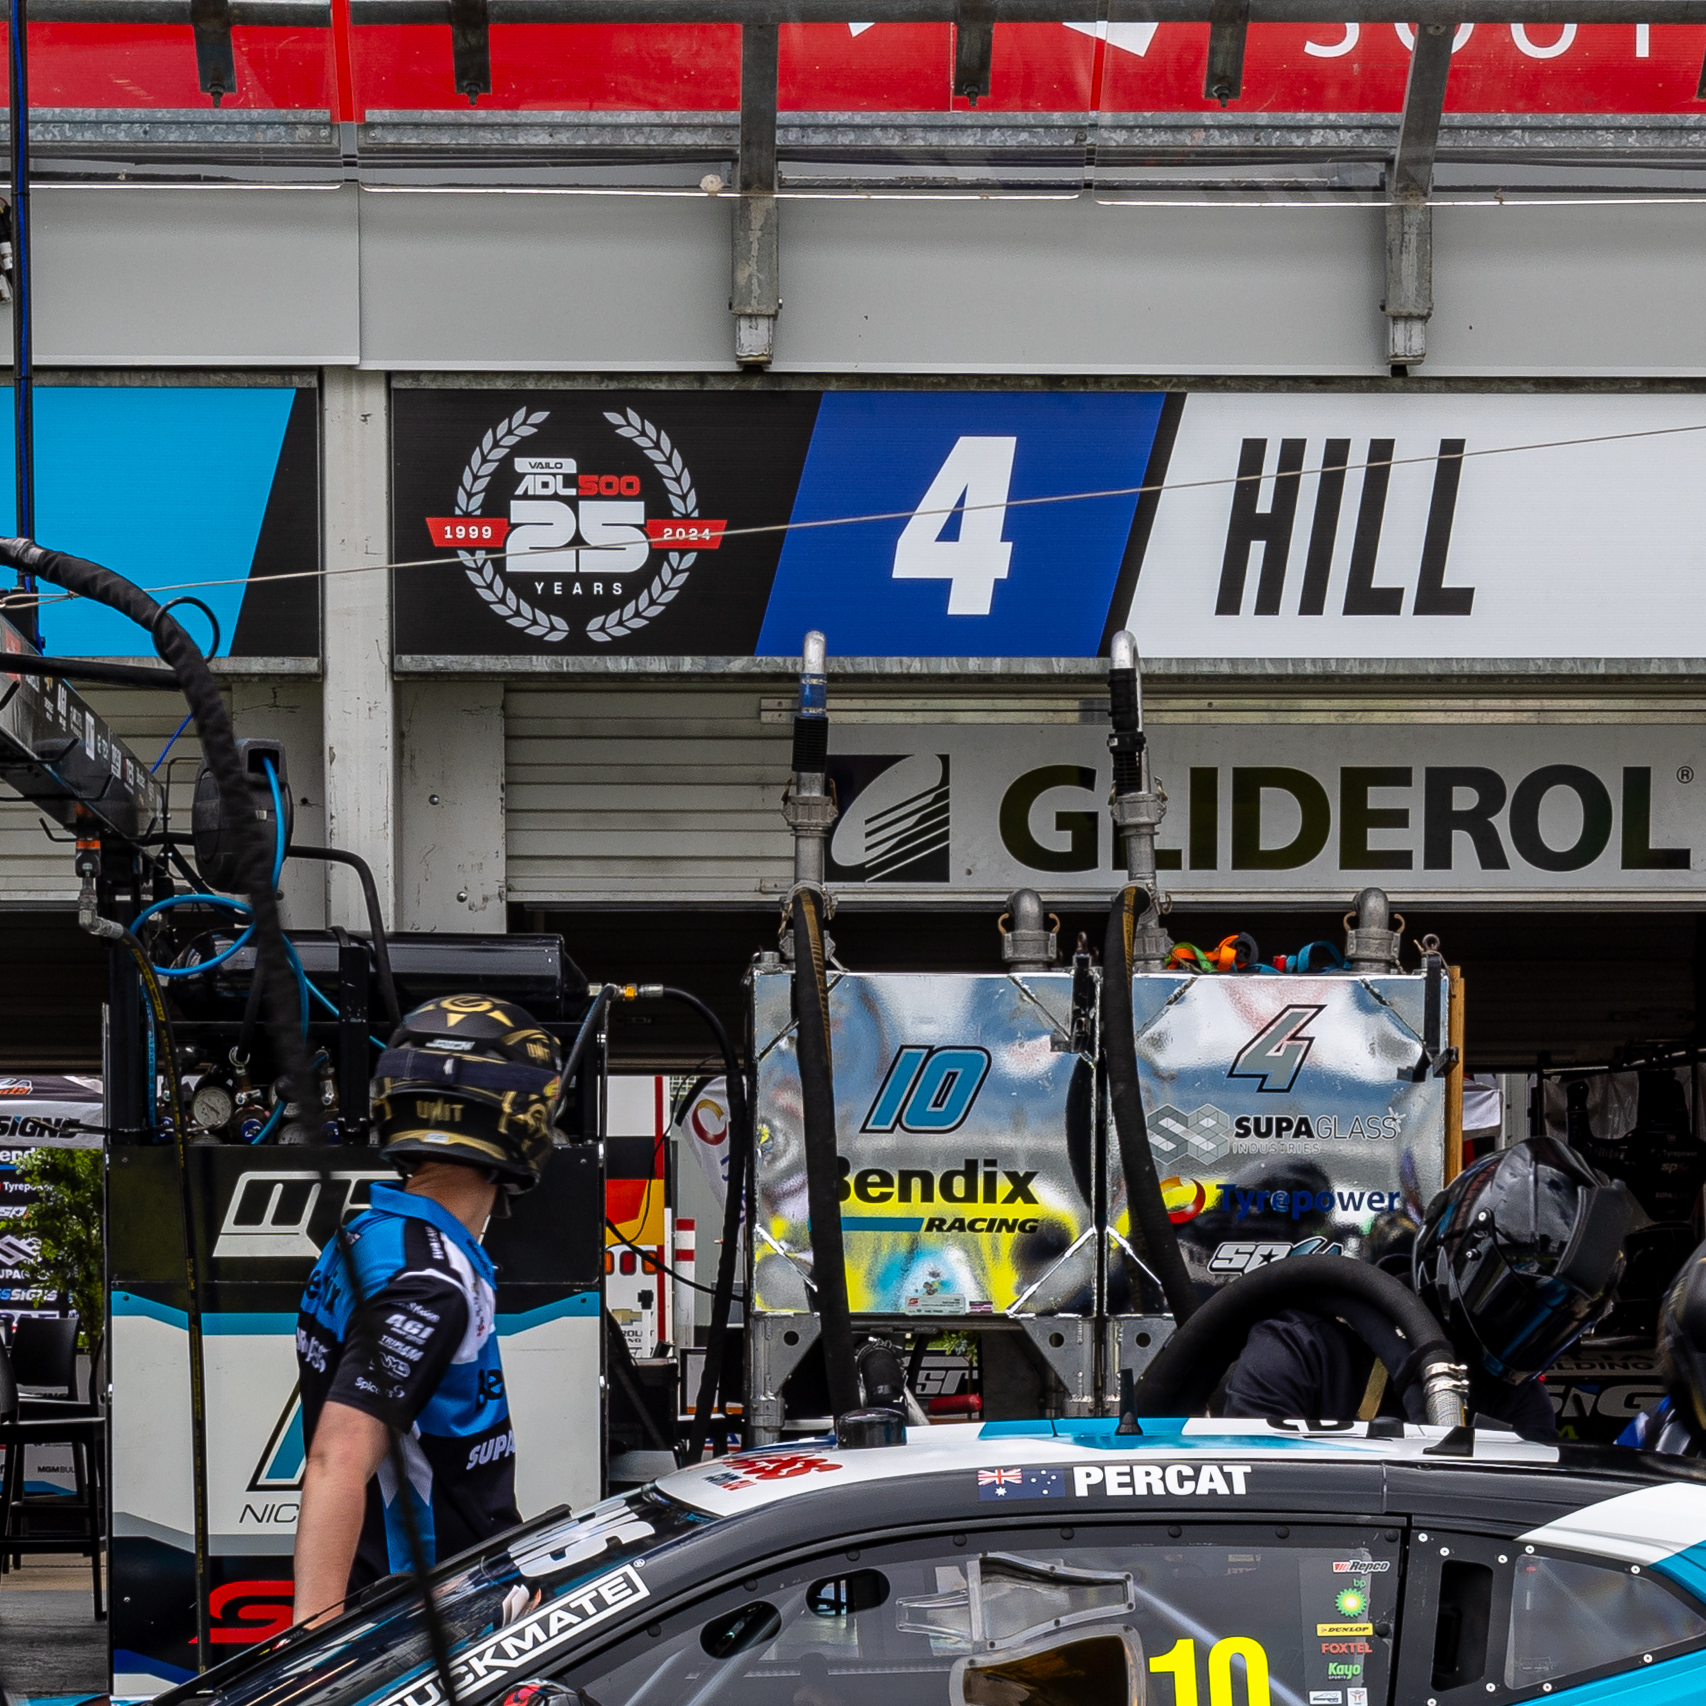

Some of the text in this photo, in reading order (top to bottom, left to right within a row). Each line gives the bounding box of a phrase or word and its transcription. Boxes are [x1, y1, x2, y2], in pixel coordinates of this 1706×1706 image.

[528, 461, 563, 470] VAILO
[444, 526, 492, 539] 1999
[663, 528, 711, 541] 2024
[893, 436, 1017, 616] 4
[1215, 438, 1475, 616] HILL
[506, 500, 649, 573] 25
[535, 582, 622, 595] YEARS
[1226, 1003, 1328, 1094] 4
[860, 1043, 993, 1135] 10
[1234, 1115, 1399, 1140] SUPAGLASS
[1232, 1141, 1321, 1155] INDUSTRIES
[1215, 1184, 1401, 1222] Tyrepower
[924, 1217, 1040, 1235] RACING
[1072, 1464, 1253, 1498] PERCAT
[1348, 1560, 1389, 1574] Repco
[1353, 1578, 1367, 1588] bp
[1321, 1642, 1373, 1655] FOXTEL
[1328, 1662, 1361, 1680] Kayo
